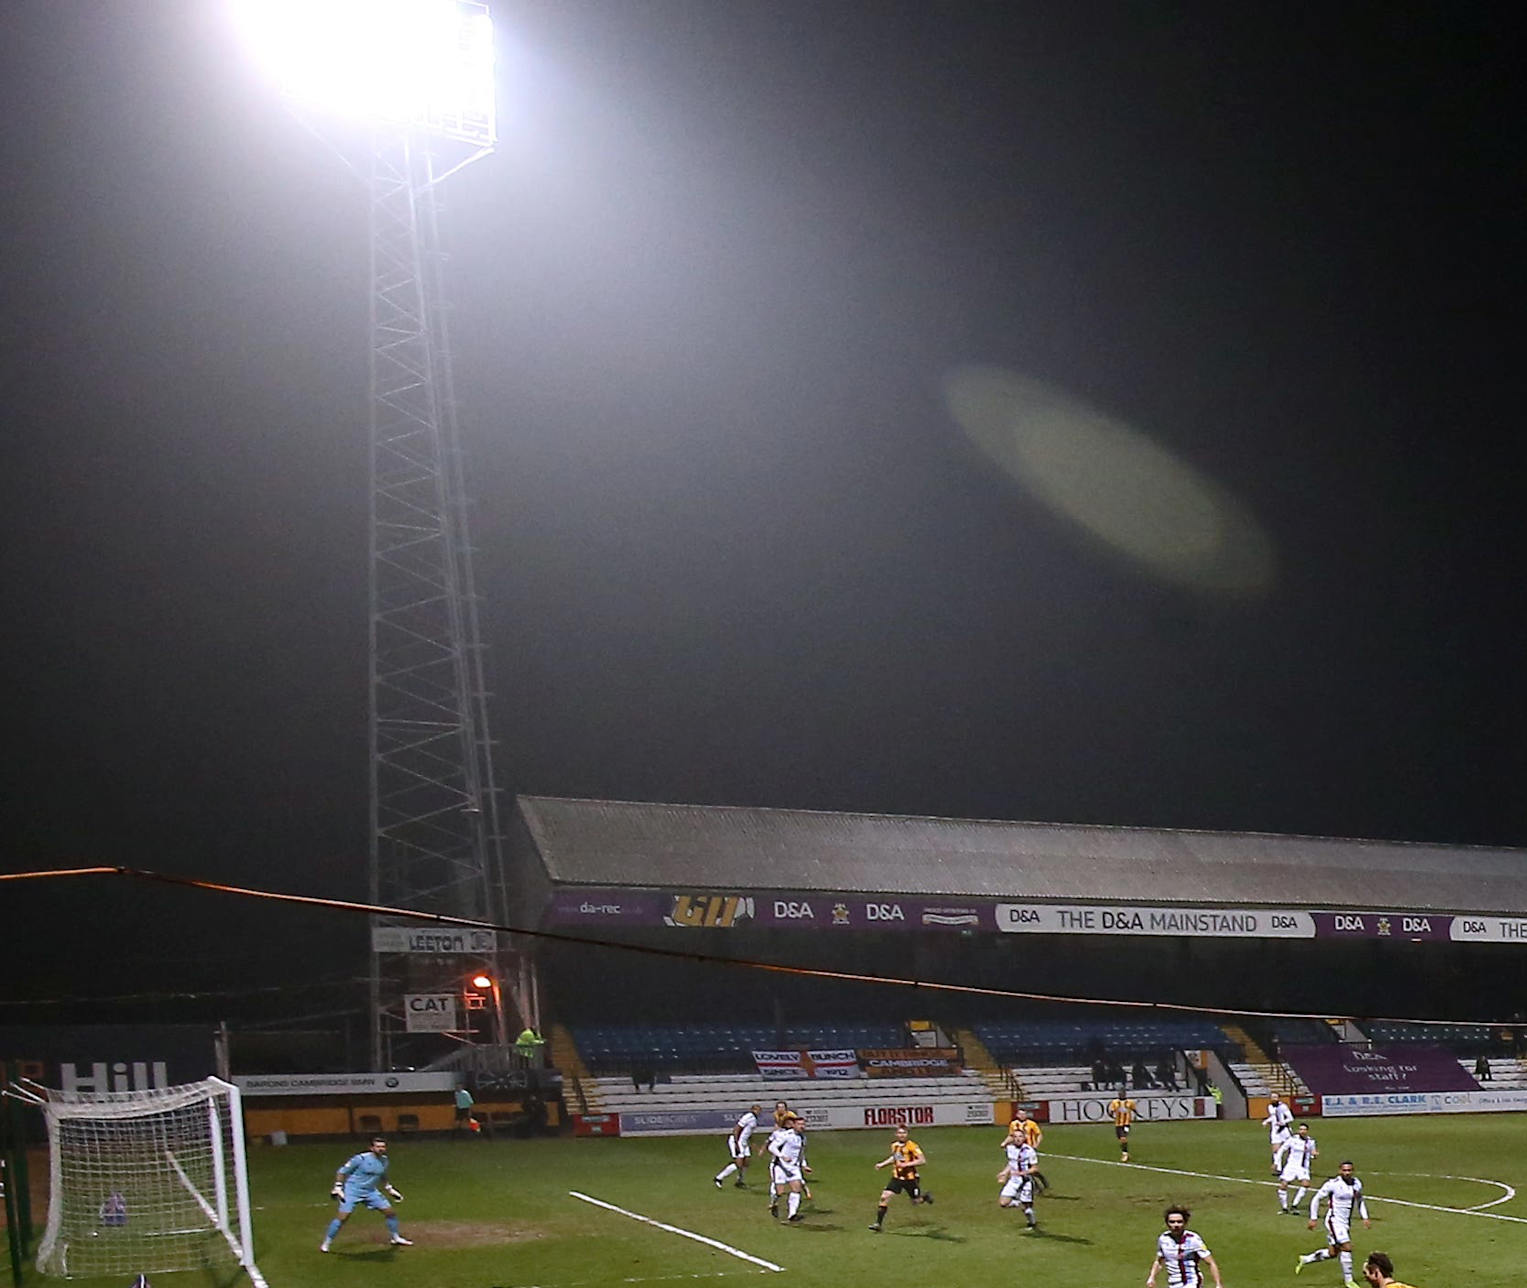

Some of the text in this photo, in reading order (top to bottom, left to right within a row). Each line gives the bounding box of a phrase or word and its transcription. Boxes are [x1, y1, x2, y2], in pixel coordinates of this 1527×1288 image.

[774, 901, 814, 918] D&A
[866, 904, 904, 921] D&A
[1009, 909, 1040, 923] D&A
[1056, 911, 1257, 933] THE D&A MAINSTAND
[1272, 916, 1298, 929] D&A
[1335, 916, 1364, 931] D&A
[1403, 918, 1431, 933] D&A
[1463, 920, 1487, 934] D&A
[1500, 923, 1527, 939] THE
[410, 999, 448, 1012] CAT
[756, 1052, 799, 1061] LOVELY
[811, 1051, 854, 1061] BUNCH
[869, 1059, 948, 1067] CAMBRIDGE
[61, 1062, 167, 1100] Hill
[1388, 1095, 1427, 1104] CLARK
[865, 1107, 934, 1125] FLORSTOR
[1062, 1099, 1190, 1121] HOEYS
